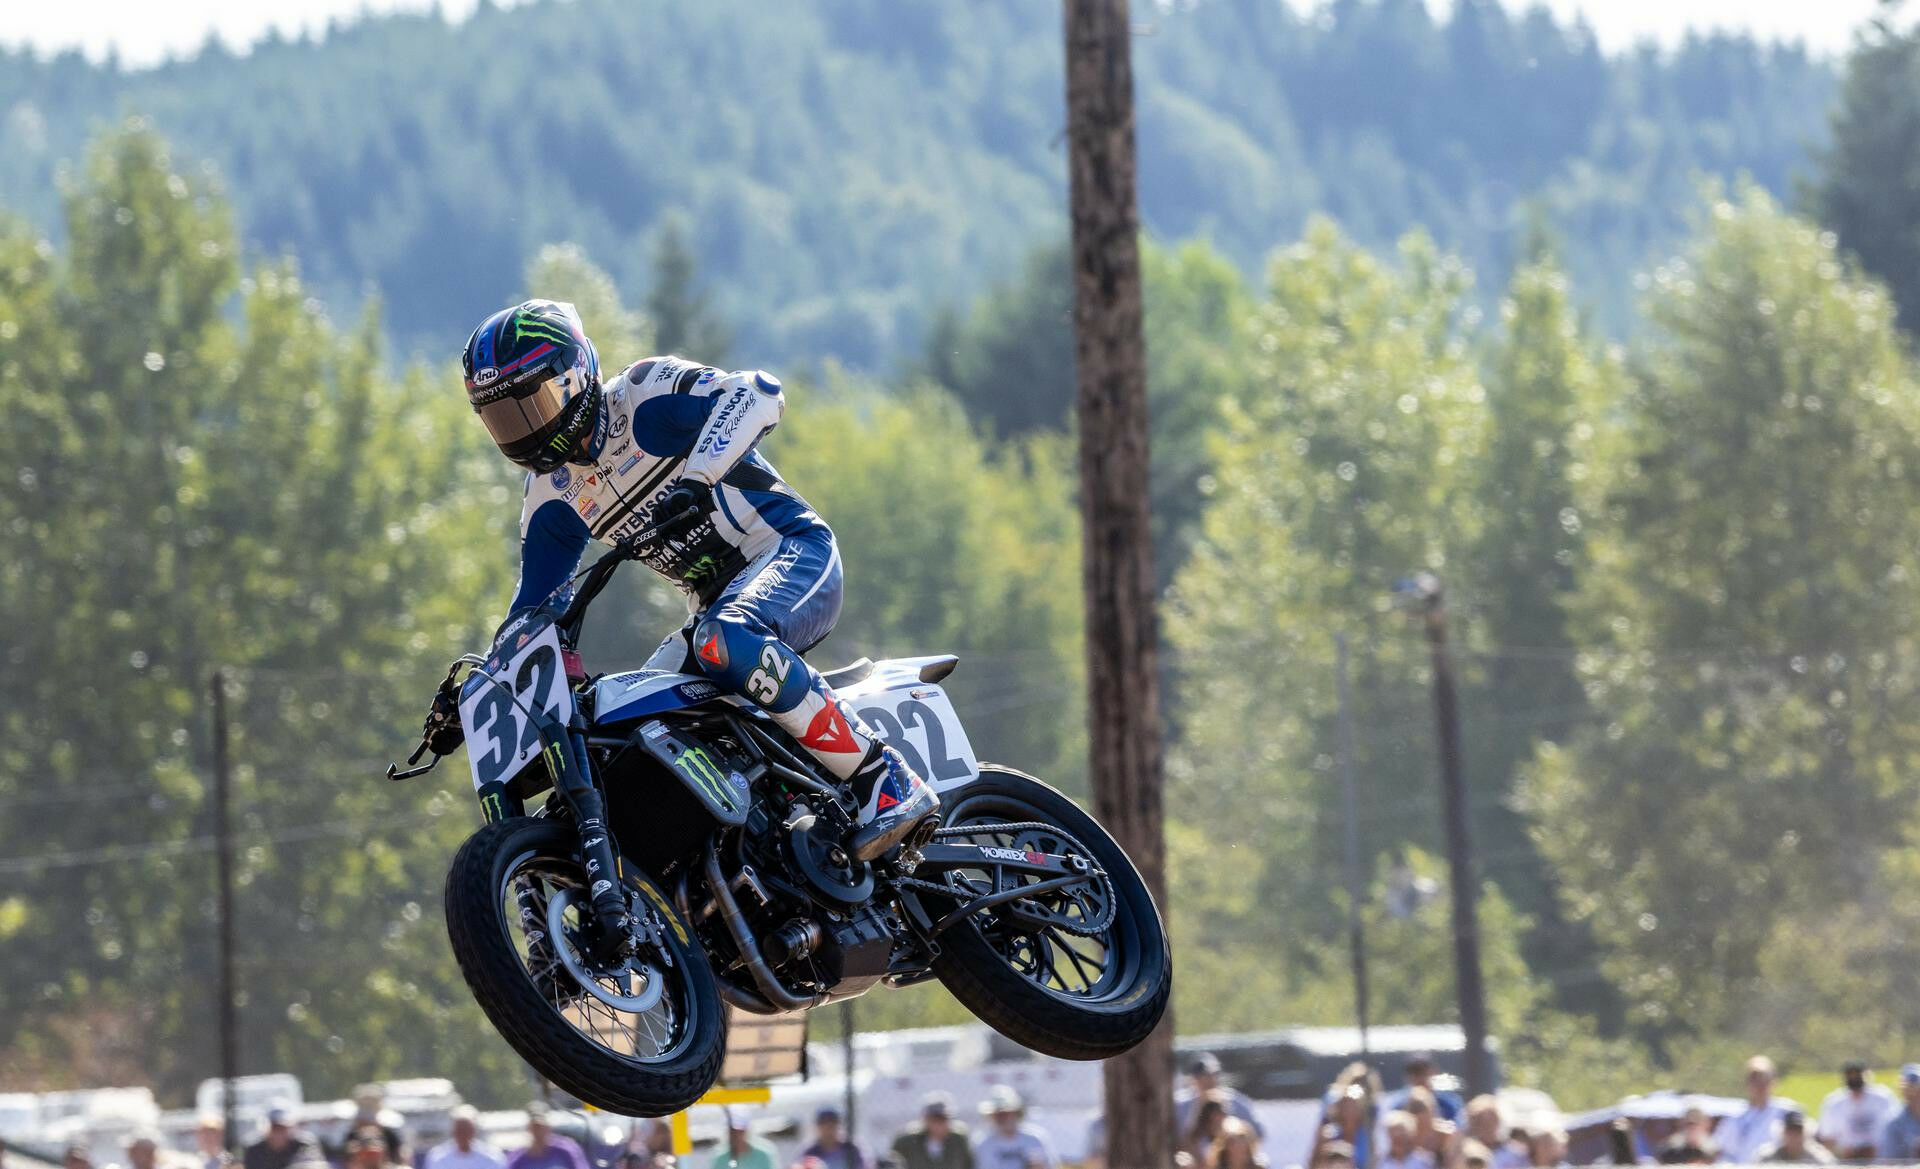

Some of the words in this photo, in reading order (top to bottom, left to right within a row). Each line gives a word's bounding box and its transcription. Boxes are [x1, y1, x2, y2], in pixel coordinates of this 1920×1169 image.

[475, 367, 497, 382] Arai
[475, 381, 512, 399] MONSTER
[568, 380, 595, 432] MONSTER
[697, 387, 748, 453] ESTENSON
[725, 392, 757, 438] Racing
[745, 644, 791, 705] 32
[473, 645, 561, 784] 32
[857, 700, 972, 784] 32
[979, 846, 1029, 862] VORTEX
